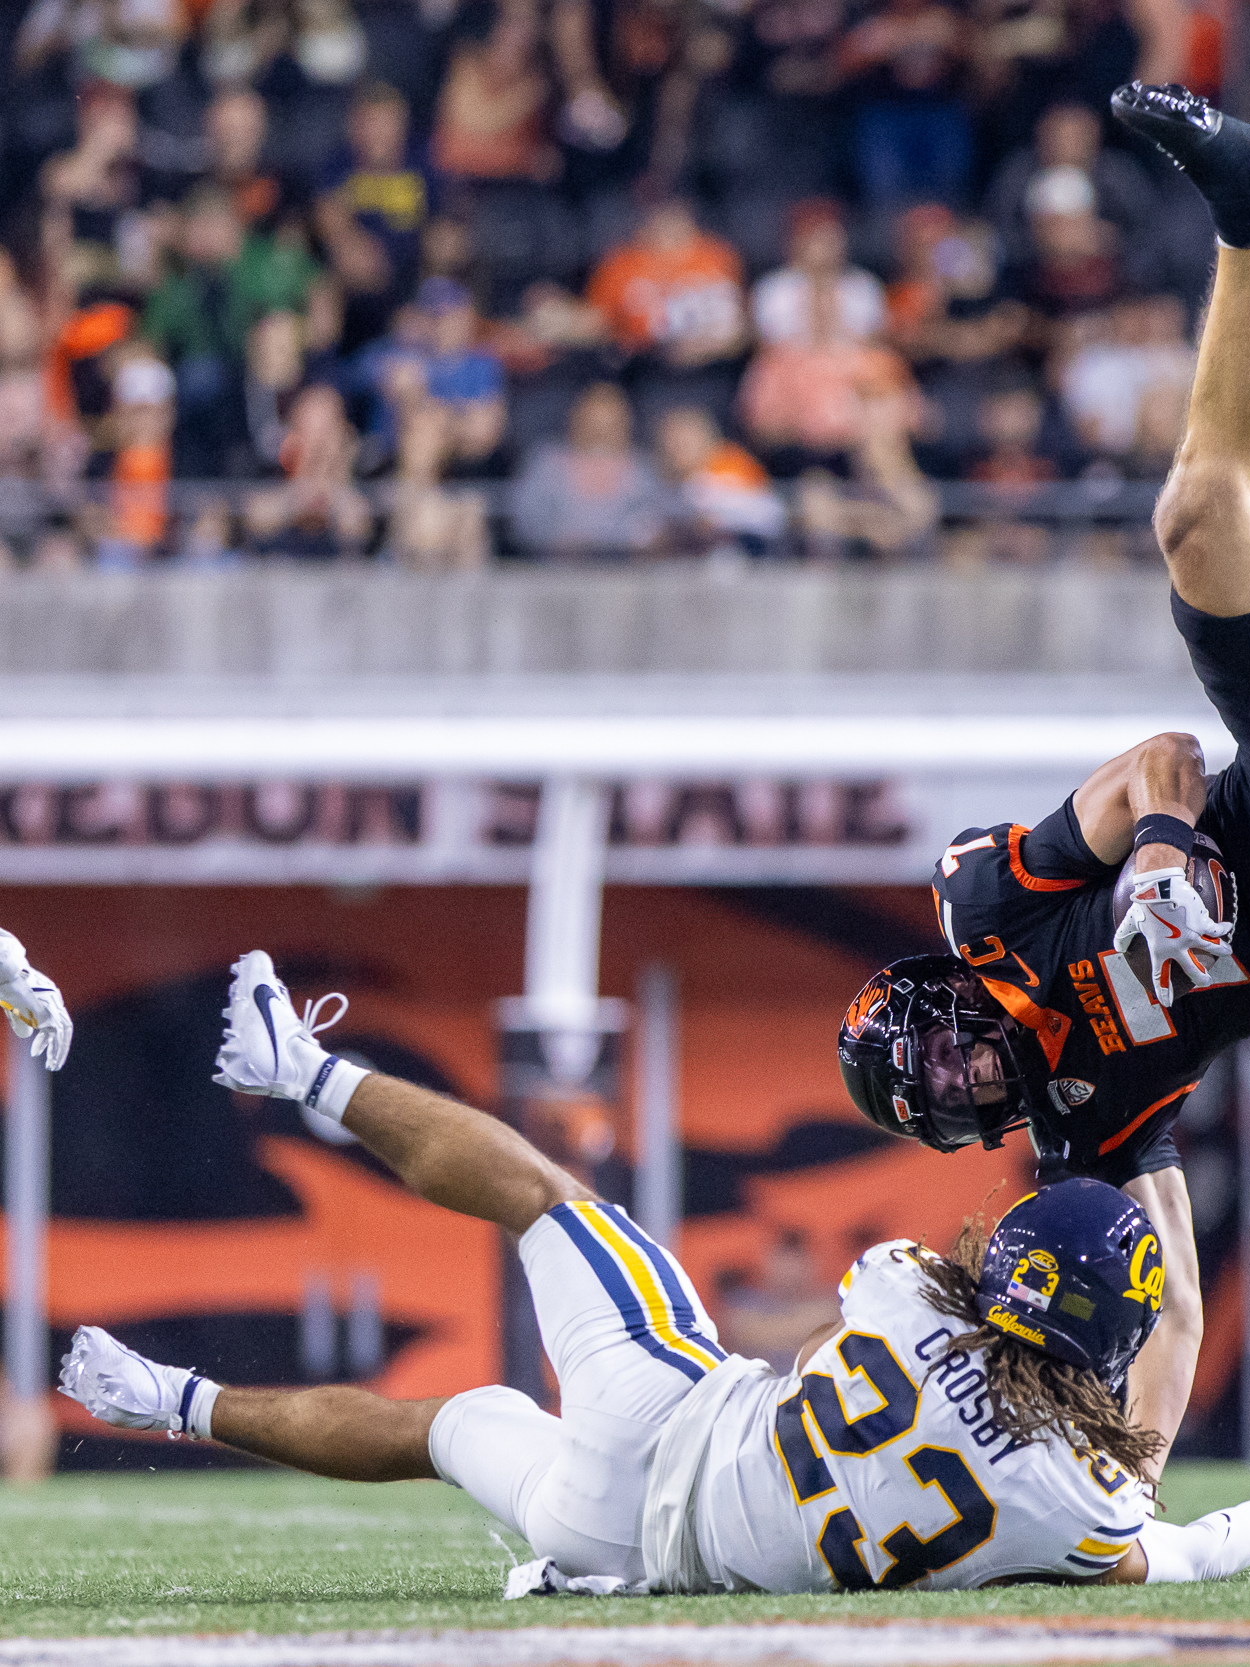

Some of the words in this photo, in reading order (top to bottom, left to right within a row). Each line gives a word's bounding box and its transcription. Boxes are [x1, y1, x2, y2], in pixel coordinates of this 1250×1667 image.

[1068, 960, 1127, 1056] BEAVS
[985, 1305, 1046, 1347] California
[914, 1327, 1026, 1466] CROSBY
[775, 1329, 998, 1593] 23
